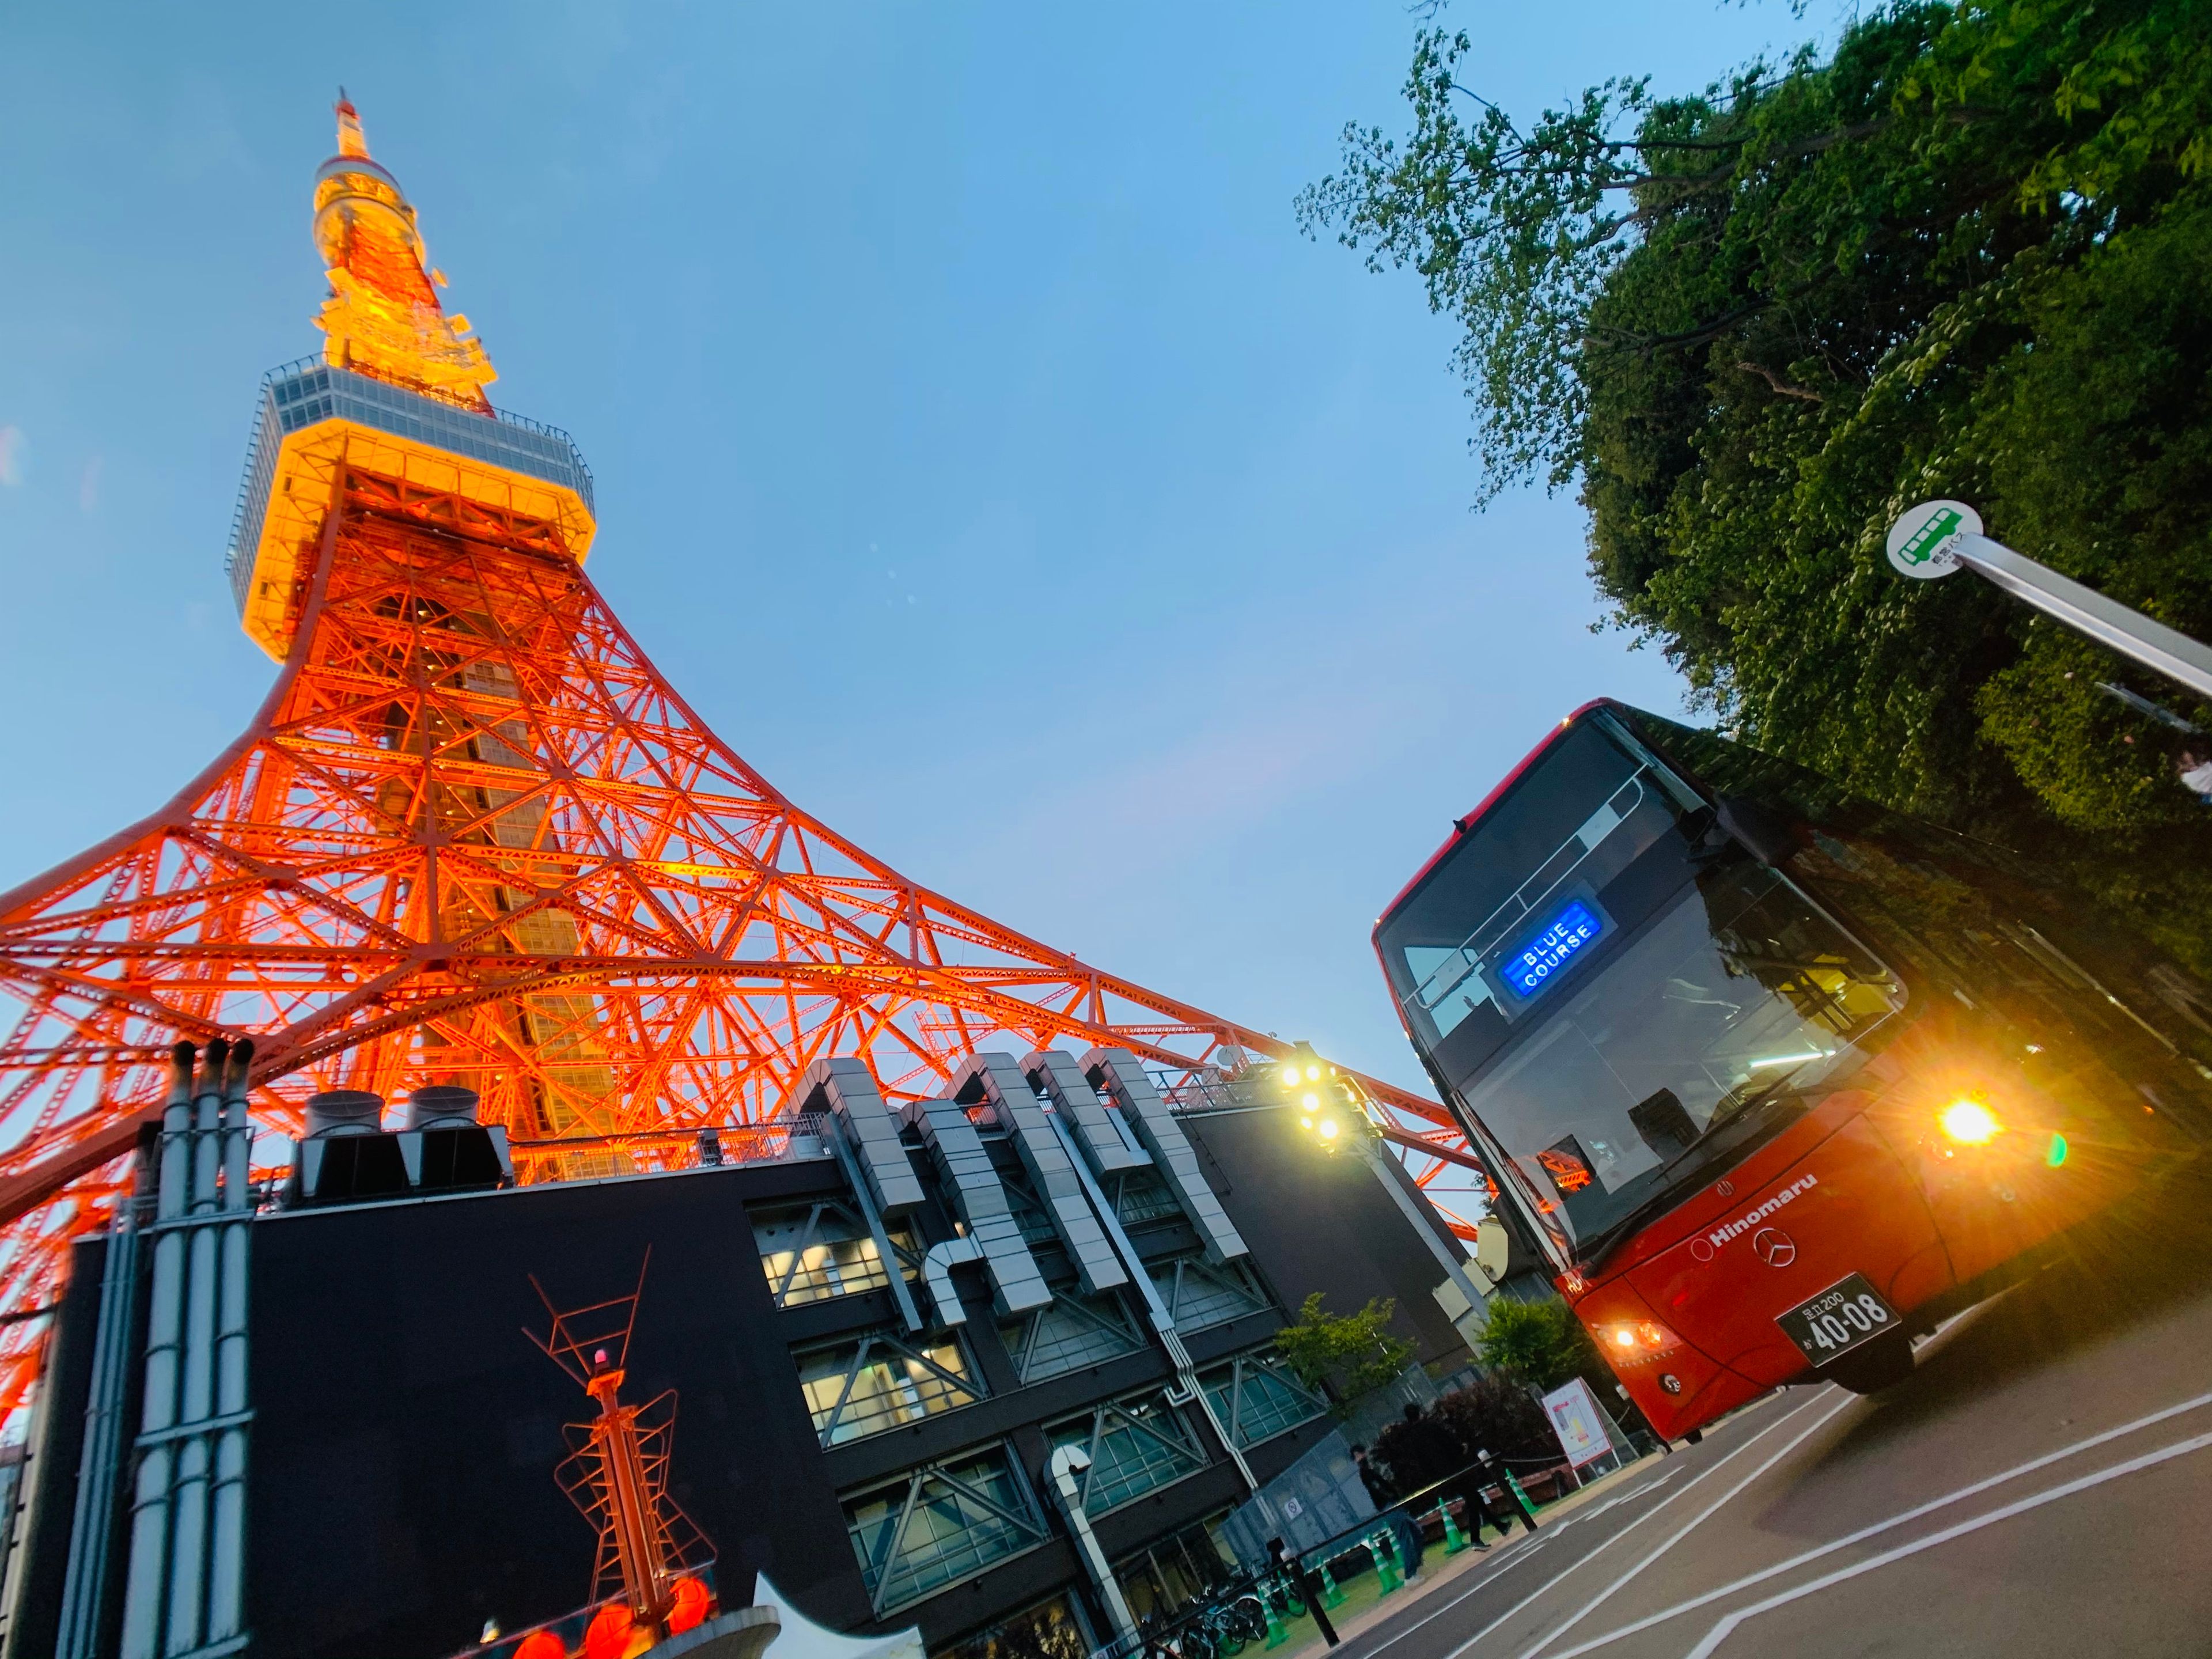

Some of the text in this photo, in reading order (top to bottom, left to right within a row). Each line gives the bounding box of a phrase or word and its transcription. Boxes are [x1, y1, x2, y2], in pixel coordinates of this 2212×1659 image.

[1523, 923, 1569, 966] BLUE
[1525, 925, 1591, 987] COURSE
[1709, 1173, 1818, 1248] Hinomaru
[1810, 1294, 1888, 1350] 40-08
